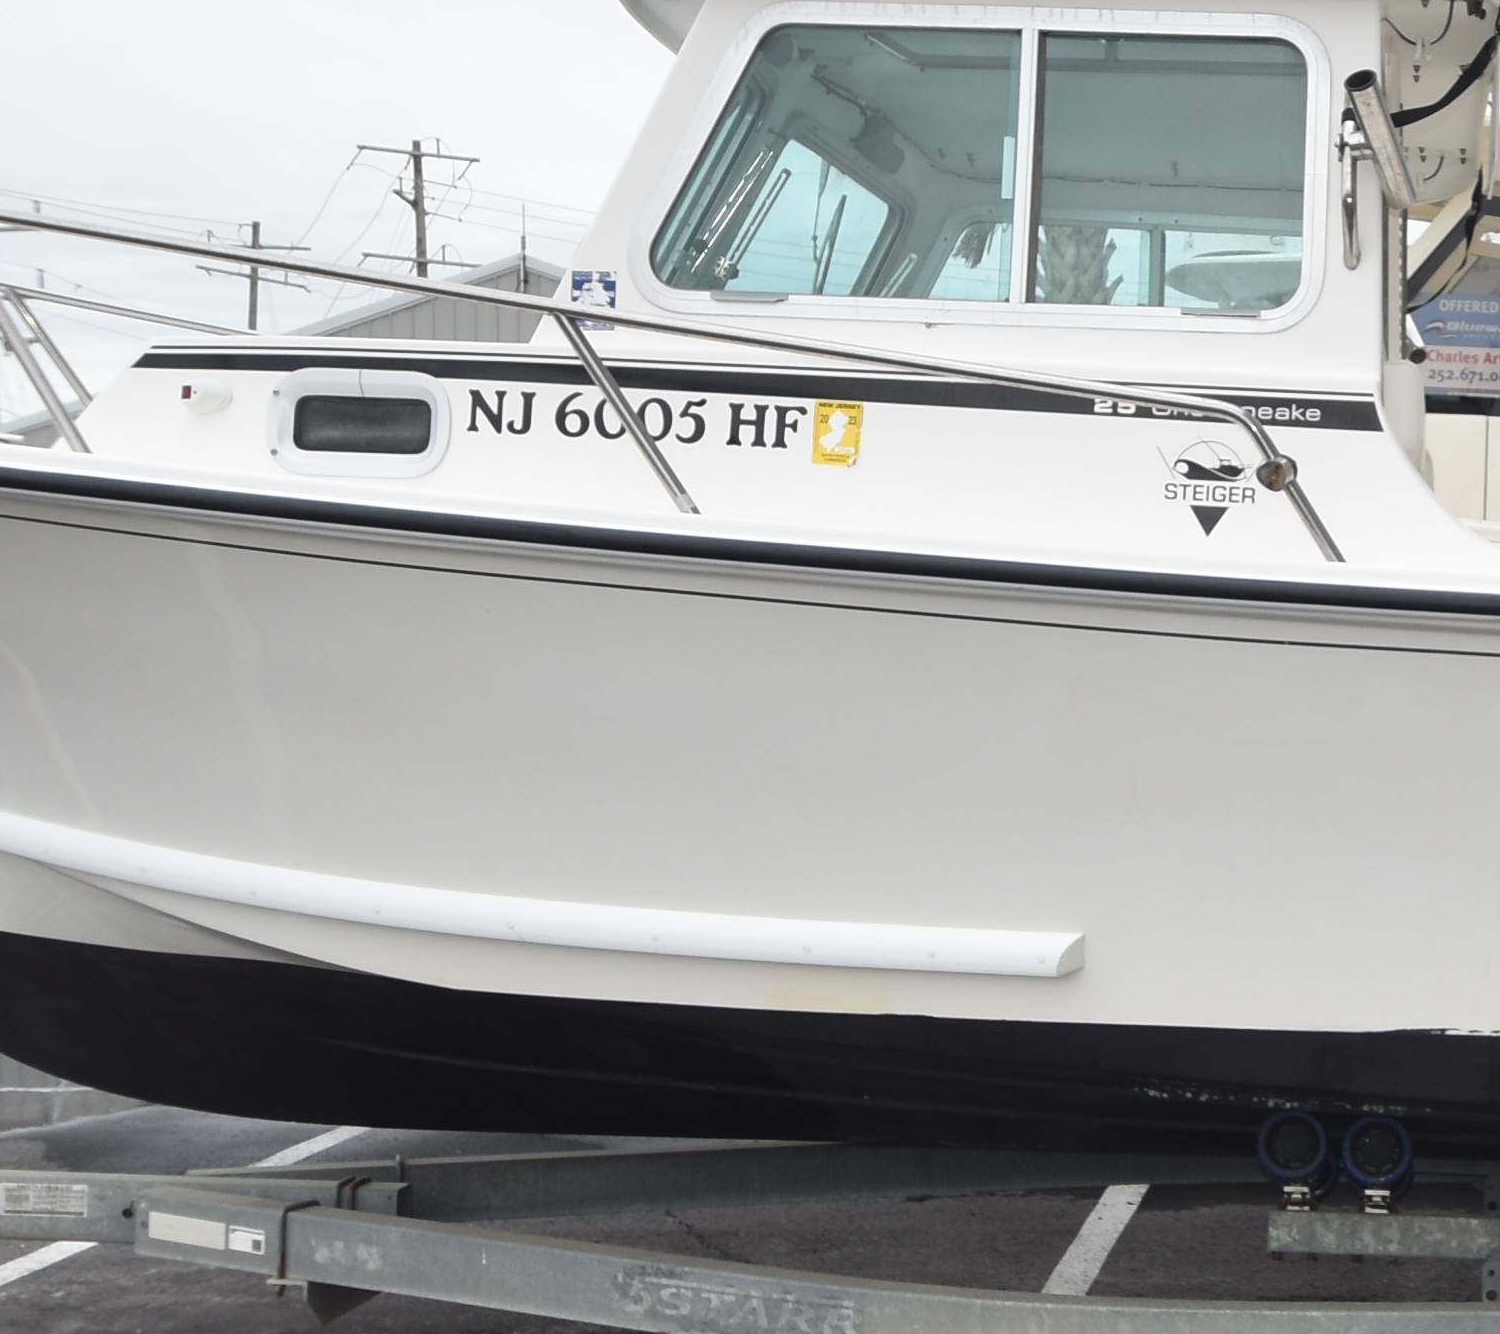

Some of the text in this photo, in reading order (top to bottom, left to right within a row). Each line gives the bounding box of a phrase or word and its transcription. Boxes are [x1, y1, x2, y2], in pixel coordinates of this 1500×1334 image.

[1439, 299, 1499, 314] OFFERED
[1427, 349, 1479, 364] Charles
[466, 388, 809, 448] NJ 6005 HF
[1164, 482, 1256, 504] STEIGER
